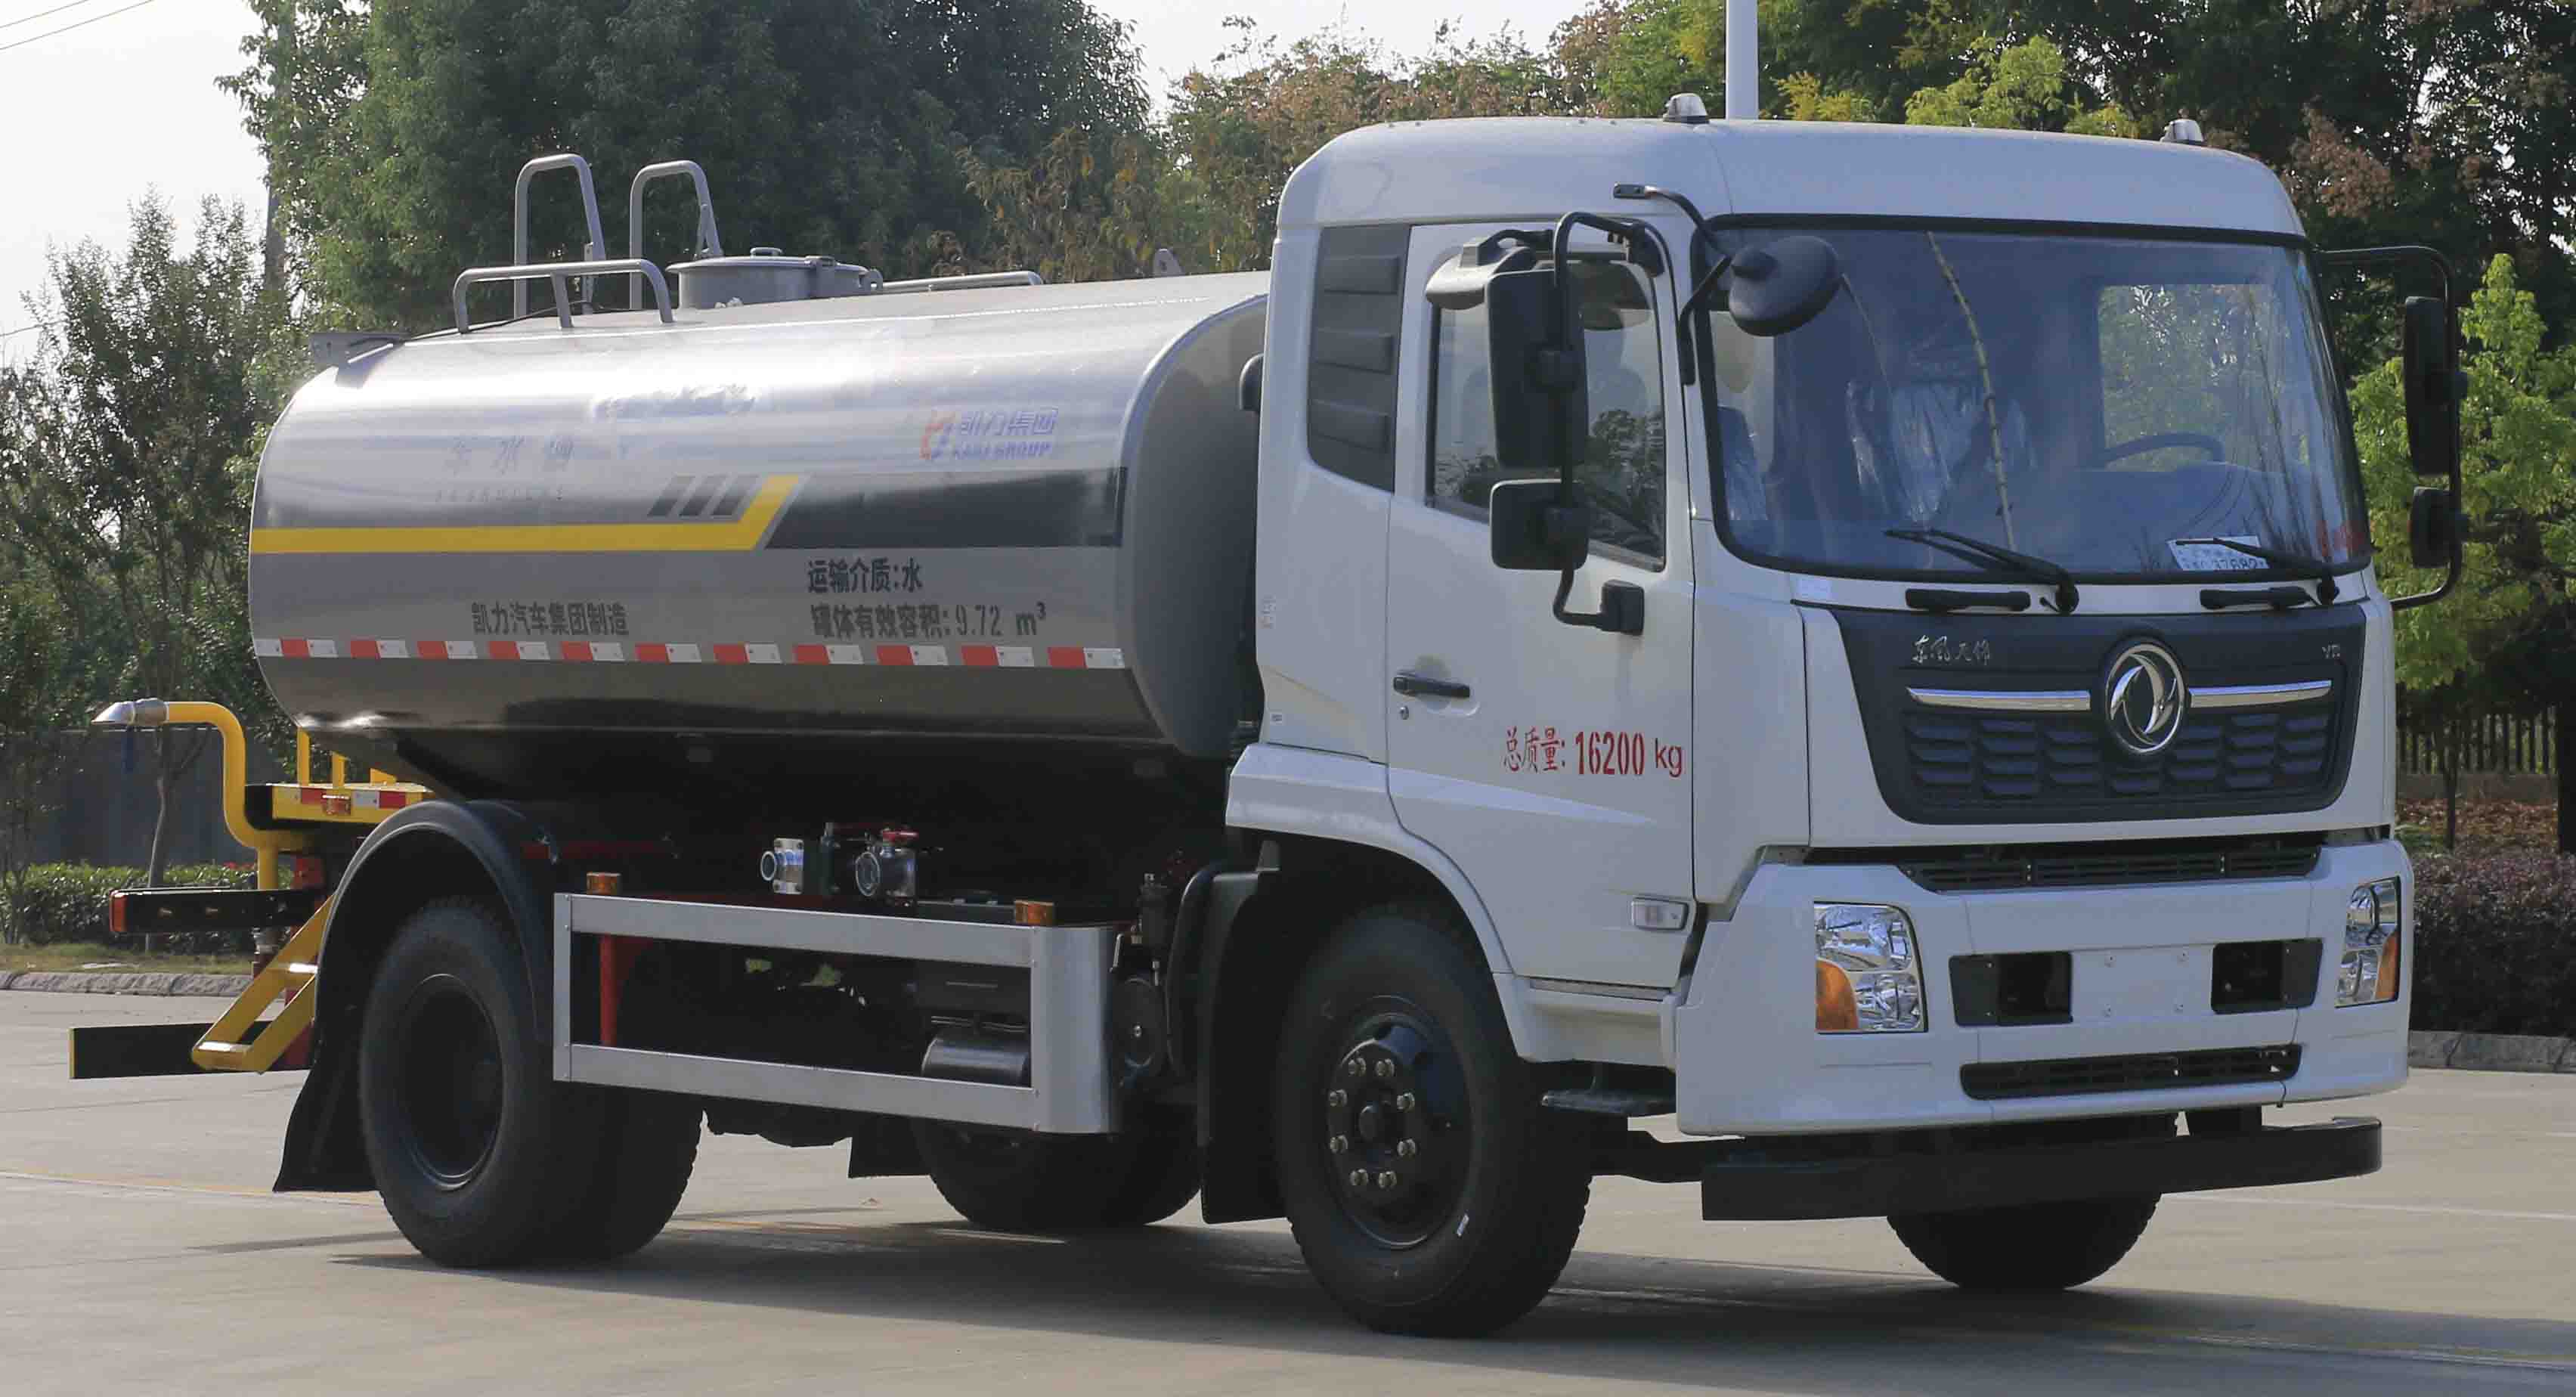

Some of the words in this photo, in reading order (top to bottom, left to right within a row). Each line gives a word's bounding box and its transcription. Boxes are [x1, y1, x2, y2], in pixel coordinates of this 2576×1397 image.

[471, 601, 630, 636] 凯力汽车集团制造
[1574, 731, 1646, 776] 16200
[1655, 738, 1684, 778] kg
